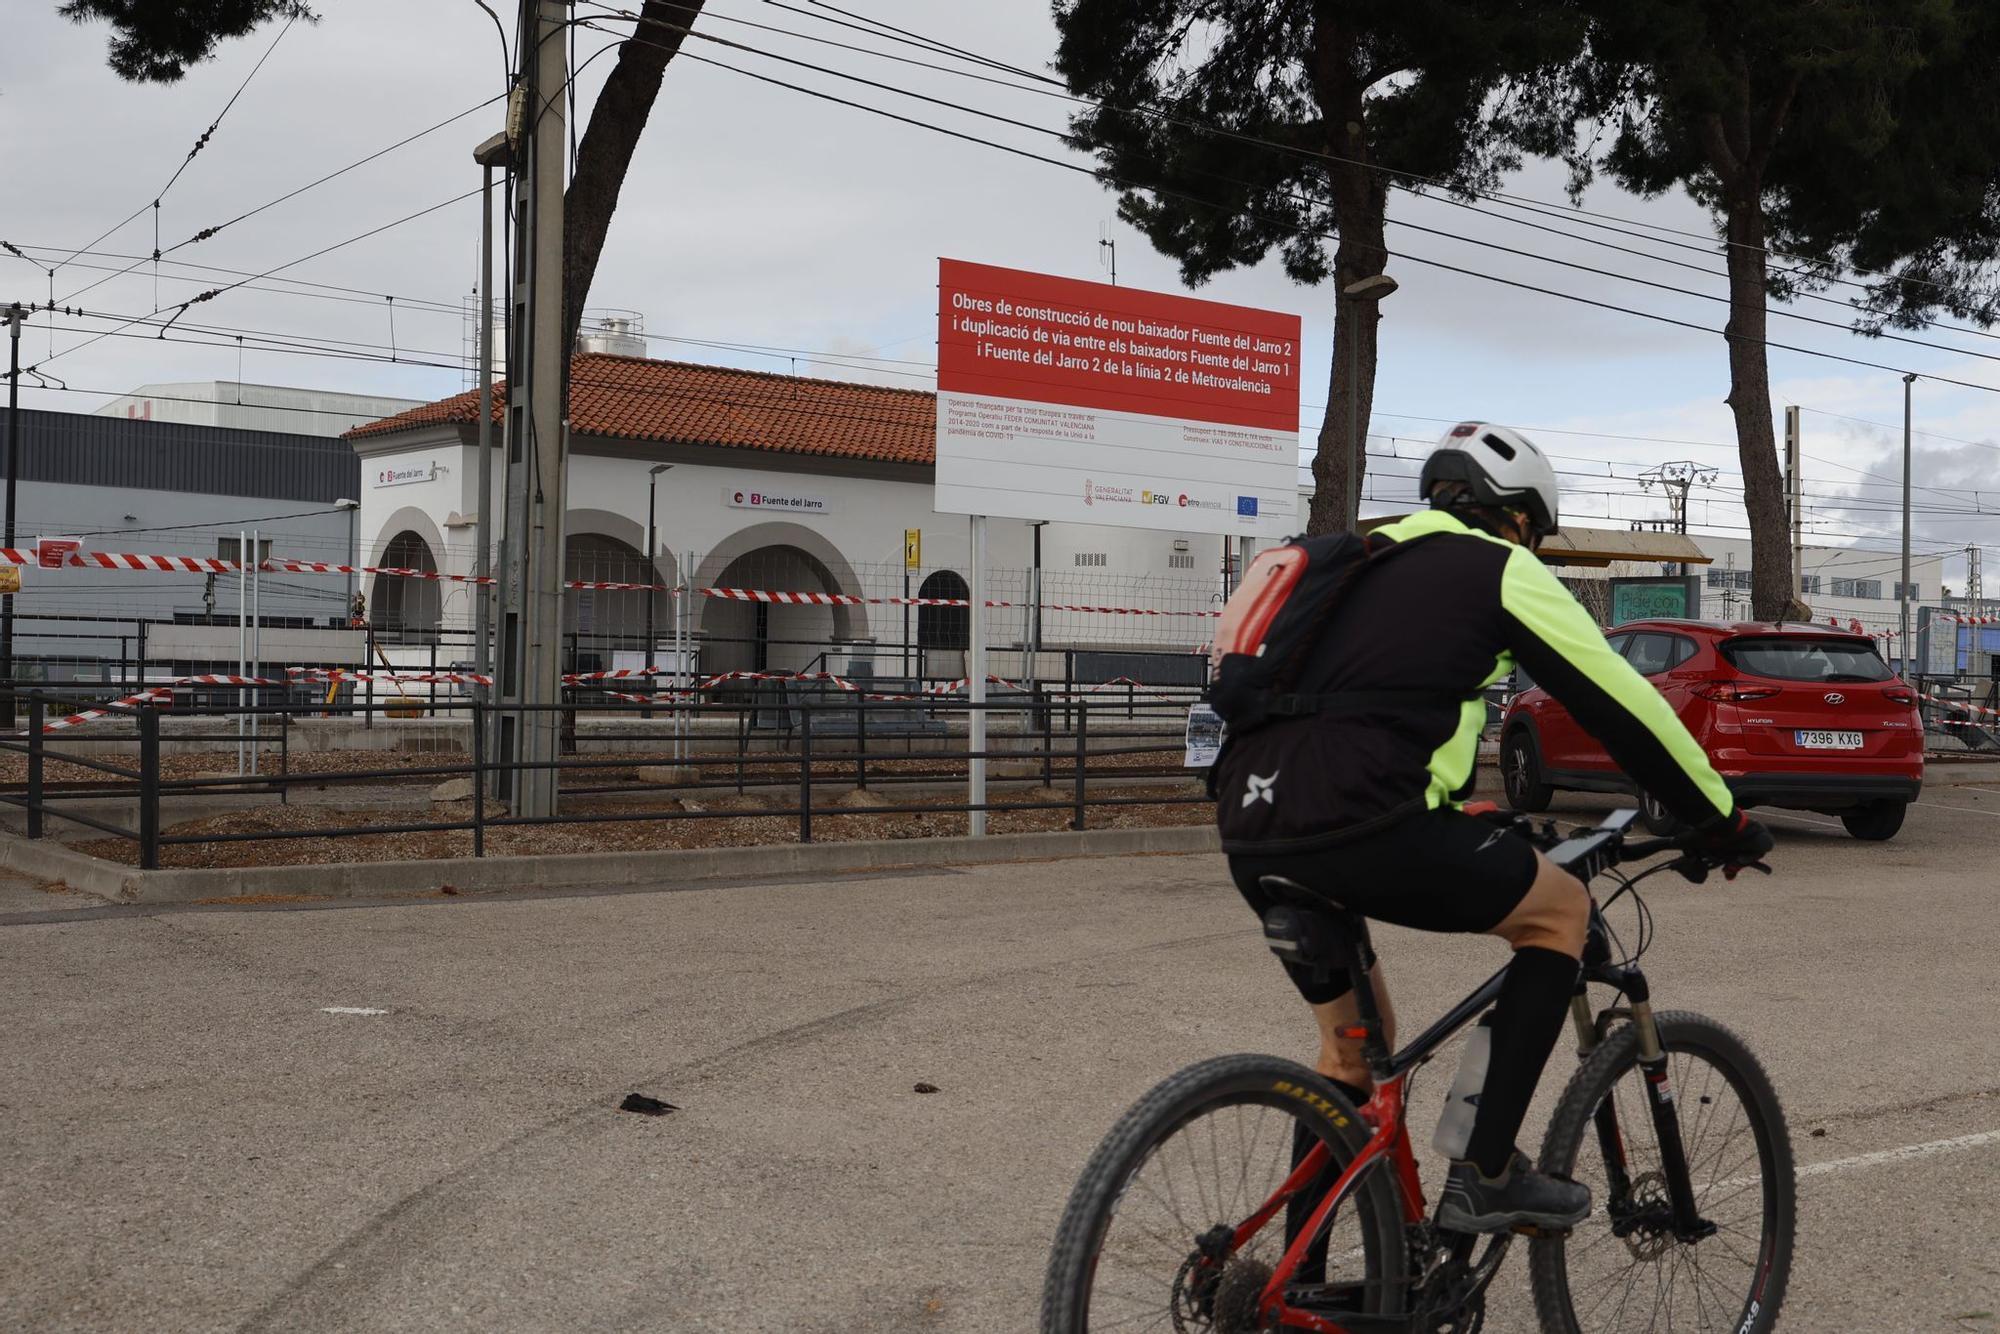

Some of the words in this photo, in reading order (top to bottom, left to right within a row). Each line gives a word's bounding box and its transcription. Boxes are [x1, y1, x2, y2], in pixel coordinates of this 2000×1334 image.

[953, 293, 992, 312] Obres
[996, 299, 1012, 316] de
[1015, 304, 1090, 327] construcció
[1094, 314, 1109, 329] de
[1112, 319, 1134, 333] nou
[1138, 320, 1189, 341] baixador
[1192, 329, 1231, 347] Fuente
[1233, 335, 1250, 350] del
[1253, 338, 1282, 355] Jarro
[1284, 343, 1292, 356] 2
[953, 315, 958, 330] i
[961, 316, 1029, 340] duplicació
[1033, 327, 1048, 342] de
[1051, 330, 1070, 346] via
[1074, 336, 1106, 351] entre
[1108, 338, 1127, 354] els
[1130, 339, 1188, 361] baixadors
[1191, 350, 1229, 368] Fuente
[1232, 356, 1249, 371] del
[1251, 359, 1281, 375] Jarro
[1283, 363, 1289, 376] 1
[977, 341, 981, 356] i
[985, 342, 1030, 363] Fuente
[1033, 350, 1052, 366] del
[1056, 353, 1089, 370] Jarro
[1092, 357, 1100, 372] 2
[1103, 359, 1118, 374] de
[1122, 360, 1133, 376] la
[1136, 362, 1161, 380] línia
[1164, 367, 1172, 381] 2
[1175, 368, 1189, 384] de
[1192, 371, 1271, 394] Metrovalencia
[1024, 416, 1058, 426] COMUNITAT
[1060, 421, 1095, 430] VALENCIANA
[762, 496, 789, 506] Fuente
[790, 498, 802, 507] del
[804, 498, 823, 508] Jarro
[1153, 494, 1170, 504] FGV
[1802, 732, 1833, 744] 7396
[1839, 733, 1862, 746] KXG
[1272, 1081, 1350, 1128] MAXXIS
